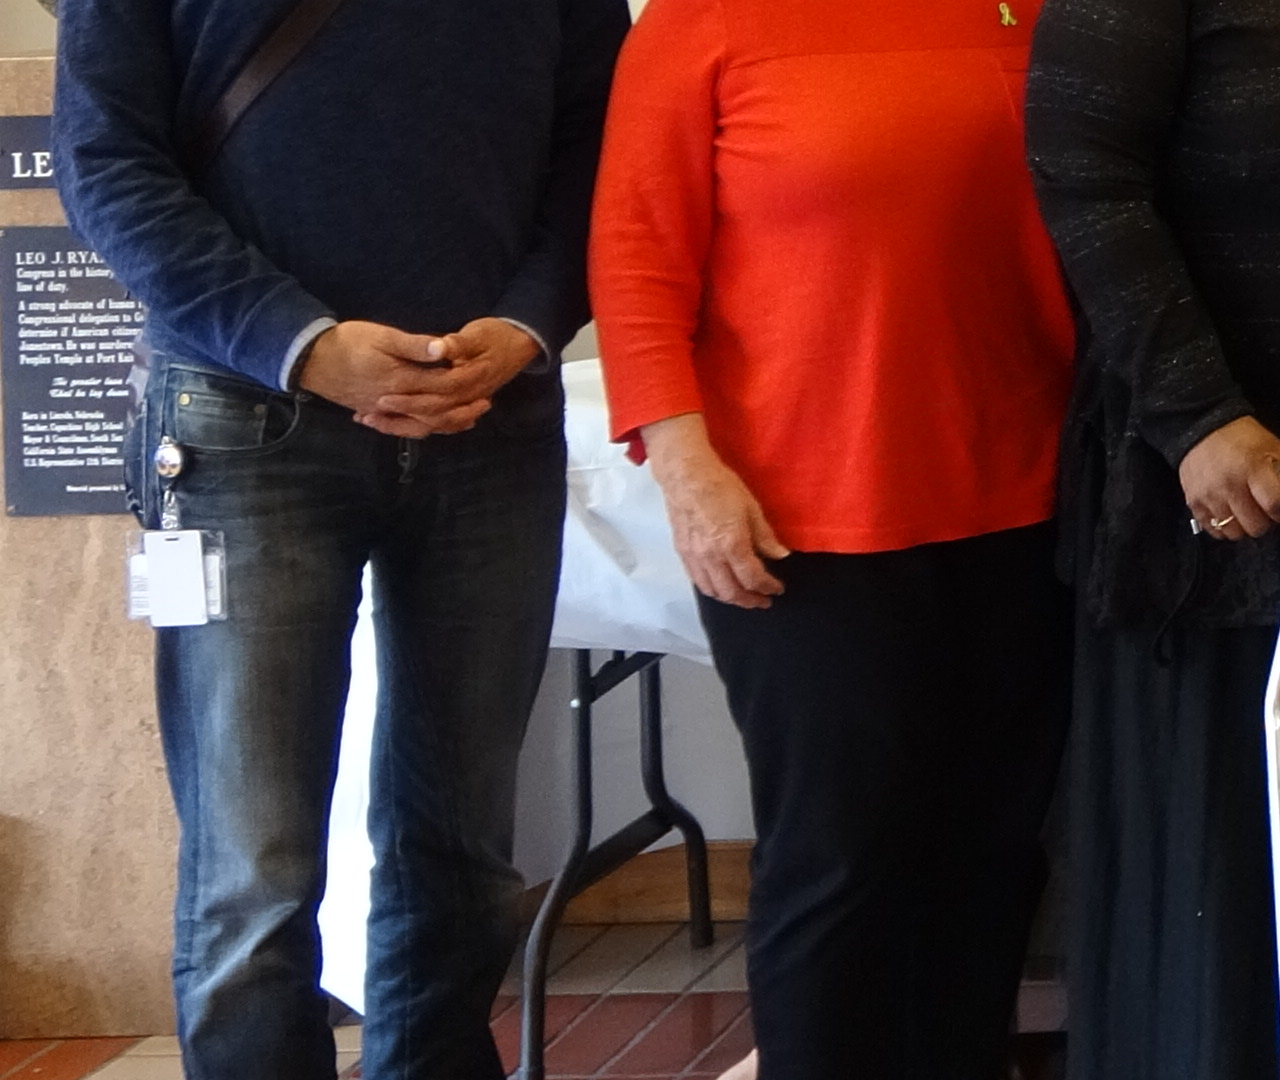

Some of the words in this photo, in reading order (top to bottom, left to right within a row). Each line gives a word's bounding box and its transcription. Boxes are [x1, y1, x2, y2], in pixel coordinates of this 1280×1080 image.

[11, 151, 54, 178] LE
[16, 252, 46, 265] LEO
[52, 252, 64, 265] J.
[67, 252, 105, 265] RYA
[17, 268, 56, 280] Congress
[58, 268, 67, 278] in
[70, 267, 83, 278] the
[36, 282, 45, 292] of
[97, 299, 107, 309] of
[123, 315, 132, 323] to
